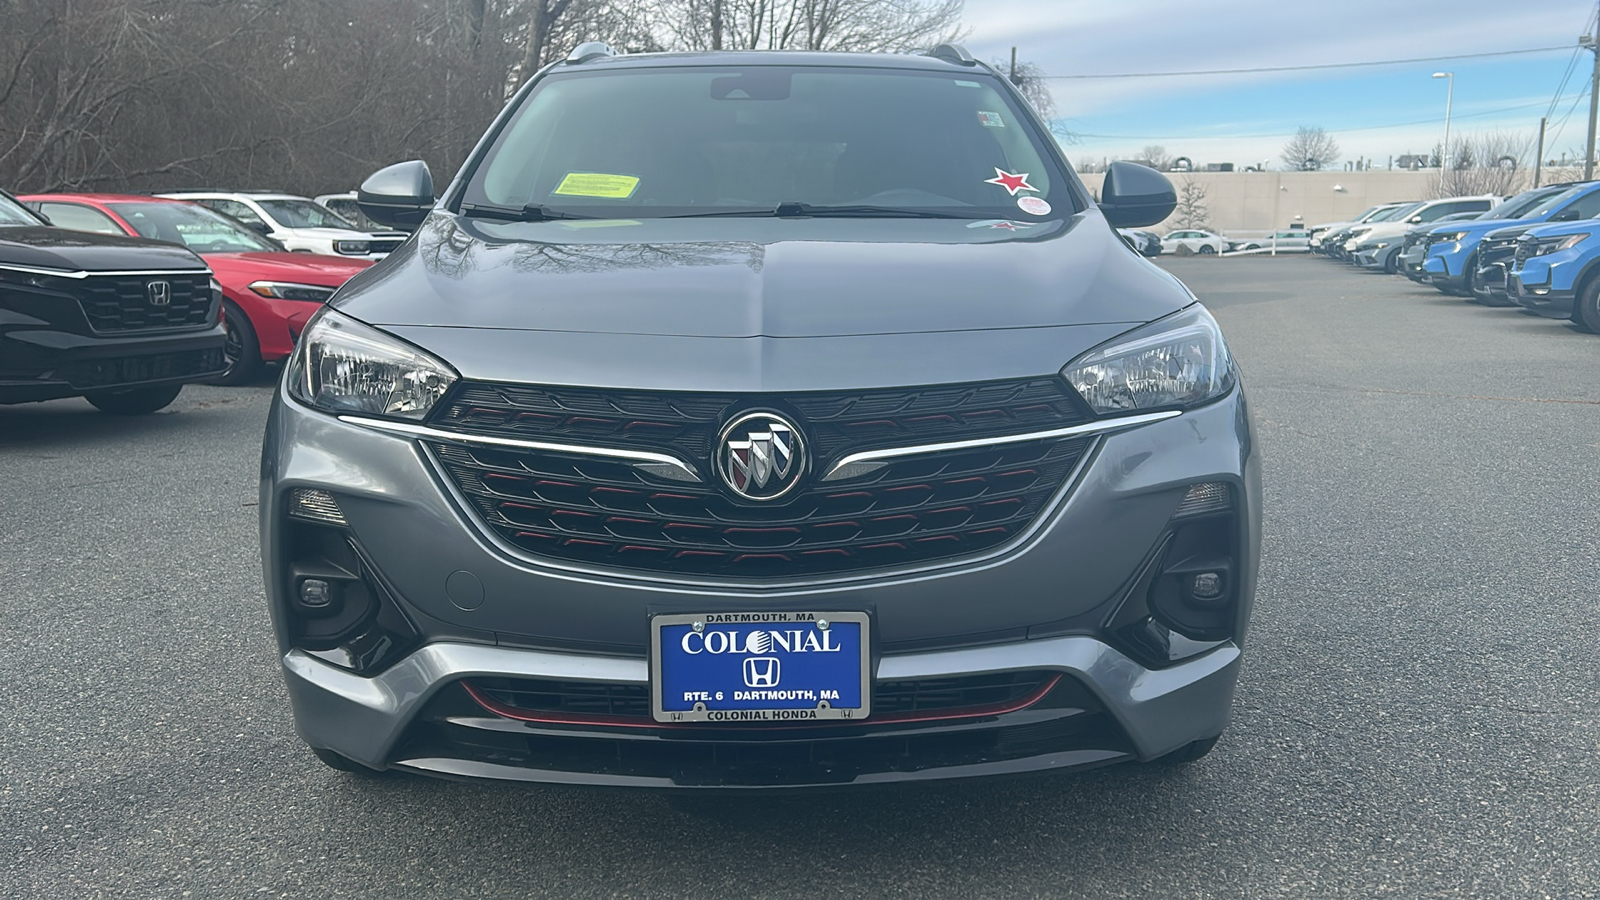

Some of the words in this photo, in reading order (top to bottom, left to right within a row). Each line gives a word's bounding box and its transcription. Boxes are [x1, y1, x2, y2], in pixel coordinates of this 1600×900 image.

[706, 614, 792, 622] DARTMOUTH,
[796, 613, 815, 621] MA
[681, 630, 841, 655] COLONIAL
[684, 691, 712, 701] RTE.
[715, 691, 723, 700] 6
[734, 690, 817, 701] DARTMOUTH,
[820, 690, 839, 700] MA
[707, 711, 769, 720] COLONIAL
[773, 710, 817, 719] HONDA
